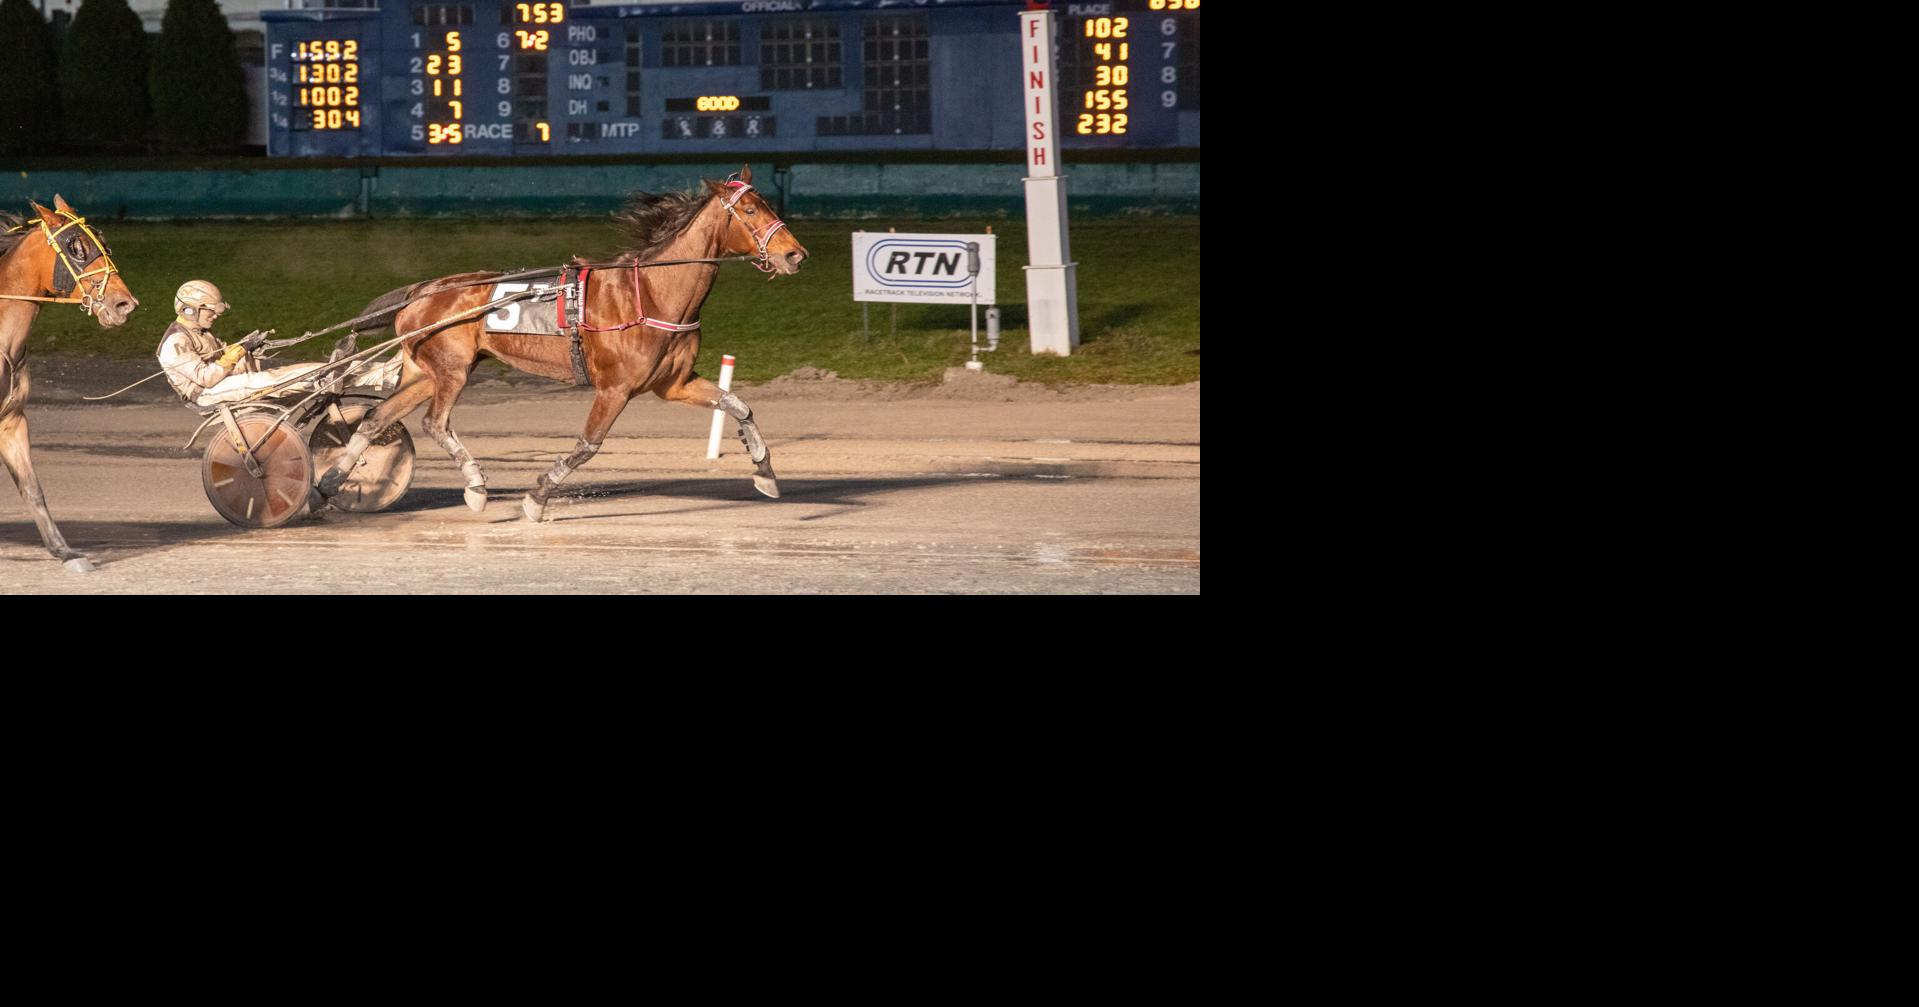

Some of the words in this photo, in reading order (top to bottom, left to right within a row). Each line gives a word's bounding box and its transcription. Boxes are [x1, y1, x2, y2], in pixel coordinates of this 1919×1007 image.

[516, 3, 564, 23] 753
[742, 1, 796, 12] OFFICIAL
[1068, 4, 1111, 15] PLACE
[568, 25, 596, 41] PHO
[1085, 17, 1129, 38] 102
[1161, 18, 1176, 35] 6
[411, 33, 420, 48] 1
[446, 31, 461, 52] 5
[497, 32, 510, 48] 6
[271, 43, 283, 59] F
[569, 49, 597, 65] OBJ
[1161, 42, 1176, 59] 7
[410, 57, 422, 73] 2
[497, 55, 510, 71] 7
[300, 63, 358, 83] 1302
[1095, 65, 1129, 86] 30
[1161, 66, 1176, 83] 8
[411, 79, 424, 95] 3
[497, 78, 510, 94] 8
[568, 74, 592, 90] INQ
[301, 86, 359, 106] 1002
[1030, 20, 1045, 165] FINISH
[1085, 90, 1129, 110] 155
[1161, 90, 1177, 108] 9
[410, 103, 424, 117] 4
[448, 100, 462, 119] 7
[498, 101, 511, 117] 9
[569, 100, 587, 115] DH
[313, 109, 360, 129] 304
[1077, 113, 1128, 134] 232
[411, 125, 424, 140] 5
[464, 123, 513, 139] RACE
[536, 122, 550, 141] 7
[601, 123, 639, 137] MTP
[885, 251, 961, 275] RTN
[487, 283, 529, 330] 5
